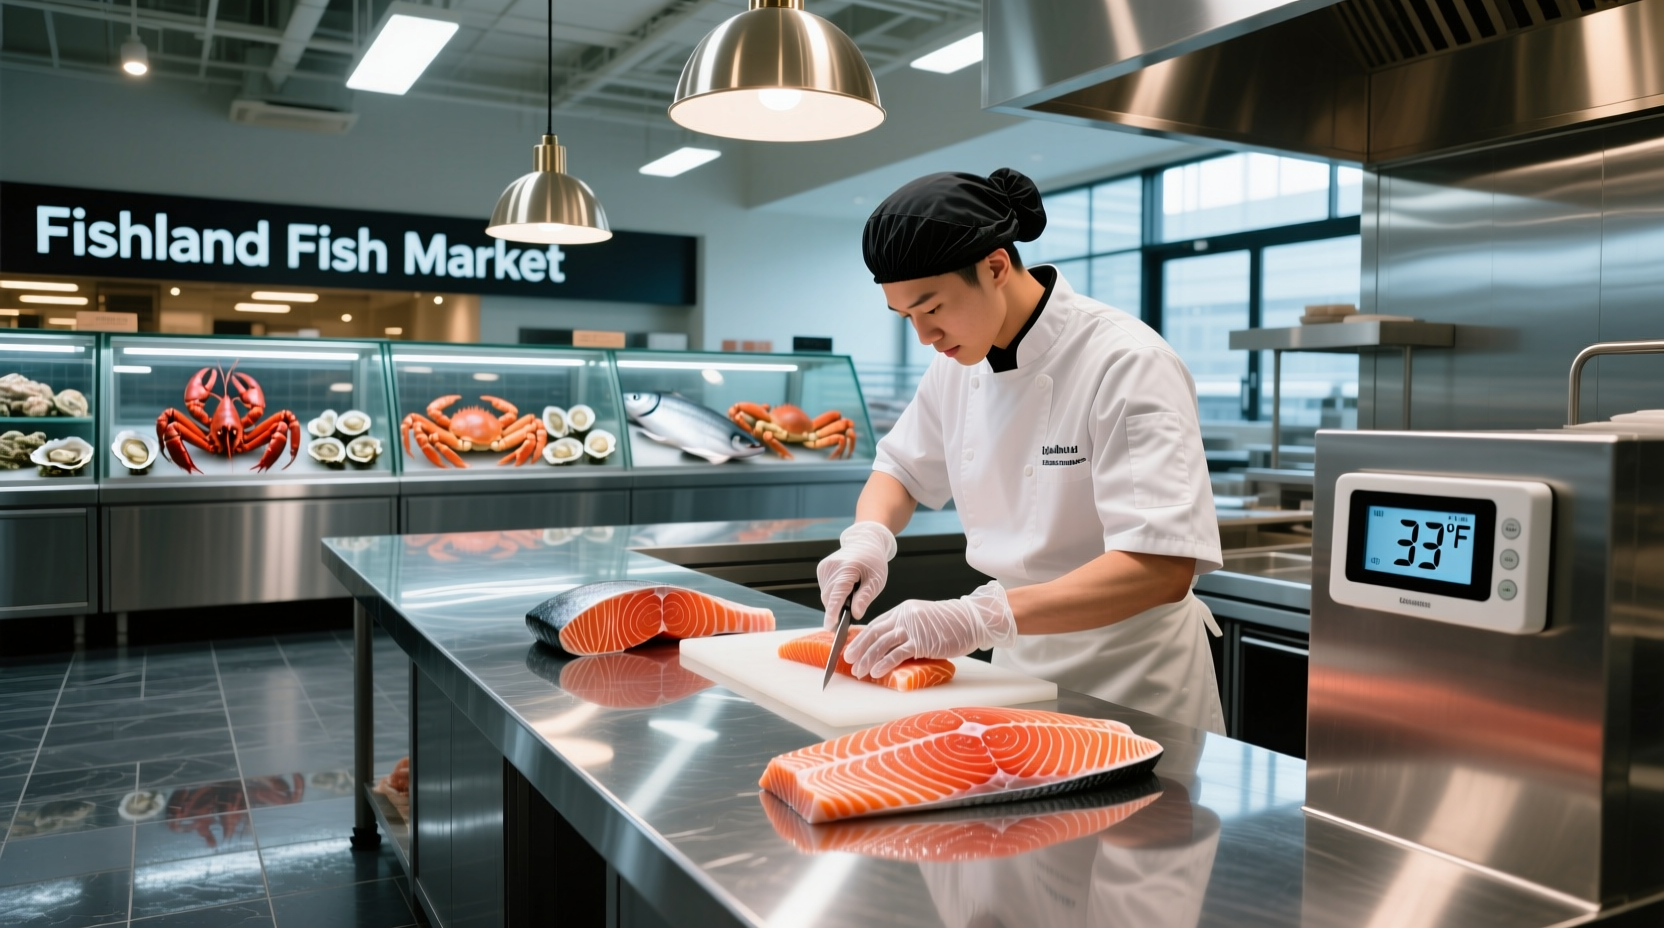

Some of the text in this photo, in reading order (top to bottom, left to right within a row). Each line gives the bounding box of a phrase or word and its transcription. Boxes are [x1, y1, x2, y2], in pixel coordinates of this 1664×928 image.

[36, 204, 566, 284] Fishland Fish Market
[1393, 518, 1471, 570] 33°F
